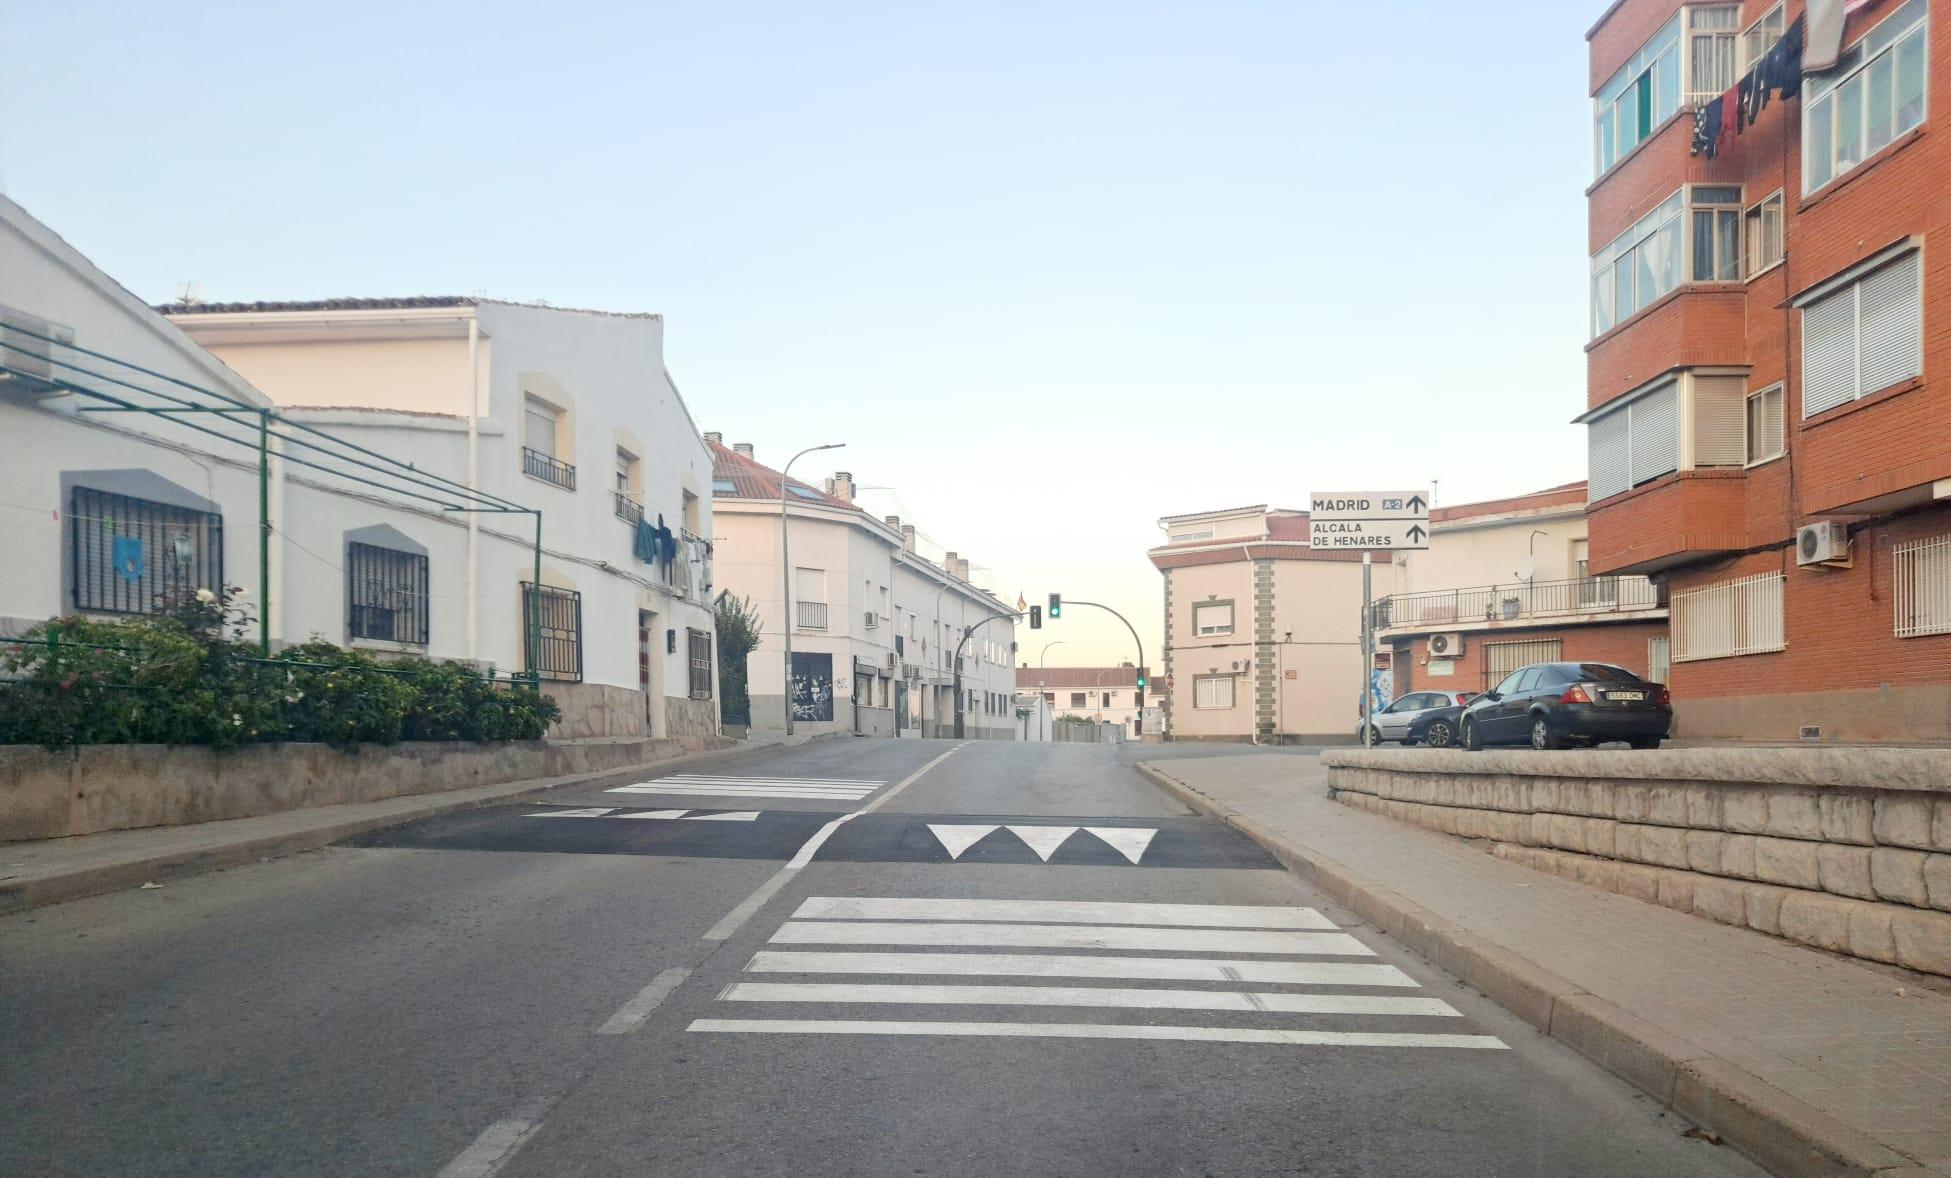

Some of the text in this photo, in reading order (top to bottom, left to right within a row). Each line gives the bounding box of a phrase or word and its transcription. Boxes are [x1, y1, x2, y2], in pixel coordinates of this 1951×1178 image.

[1312, 499, 1401, 511] MADRID A-2
[1313, 523, 1362, 533] ALCALA
[1313, 536, 1392, 546] DE HENARES
